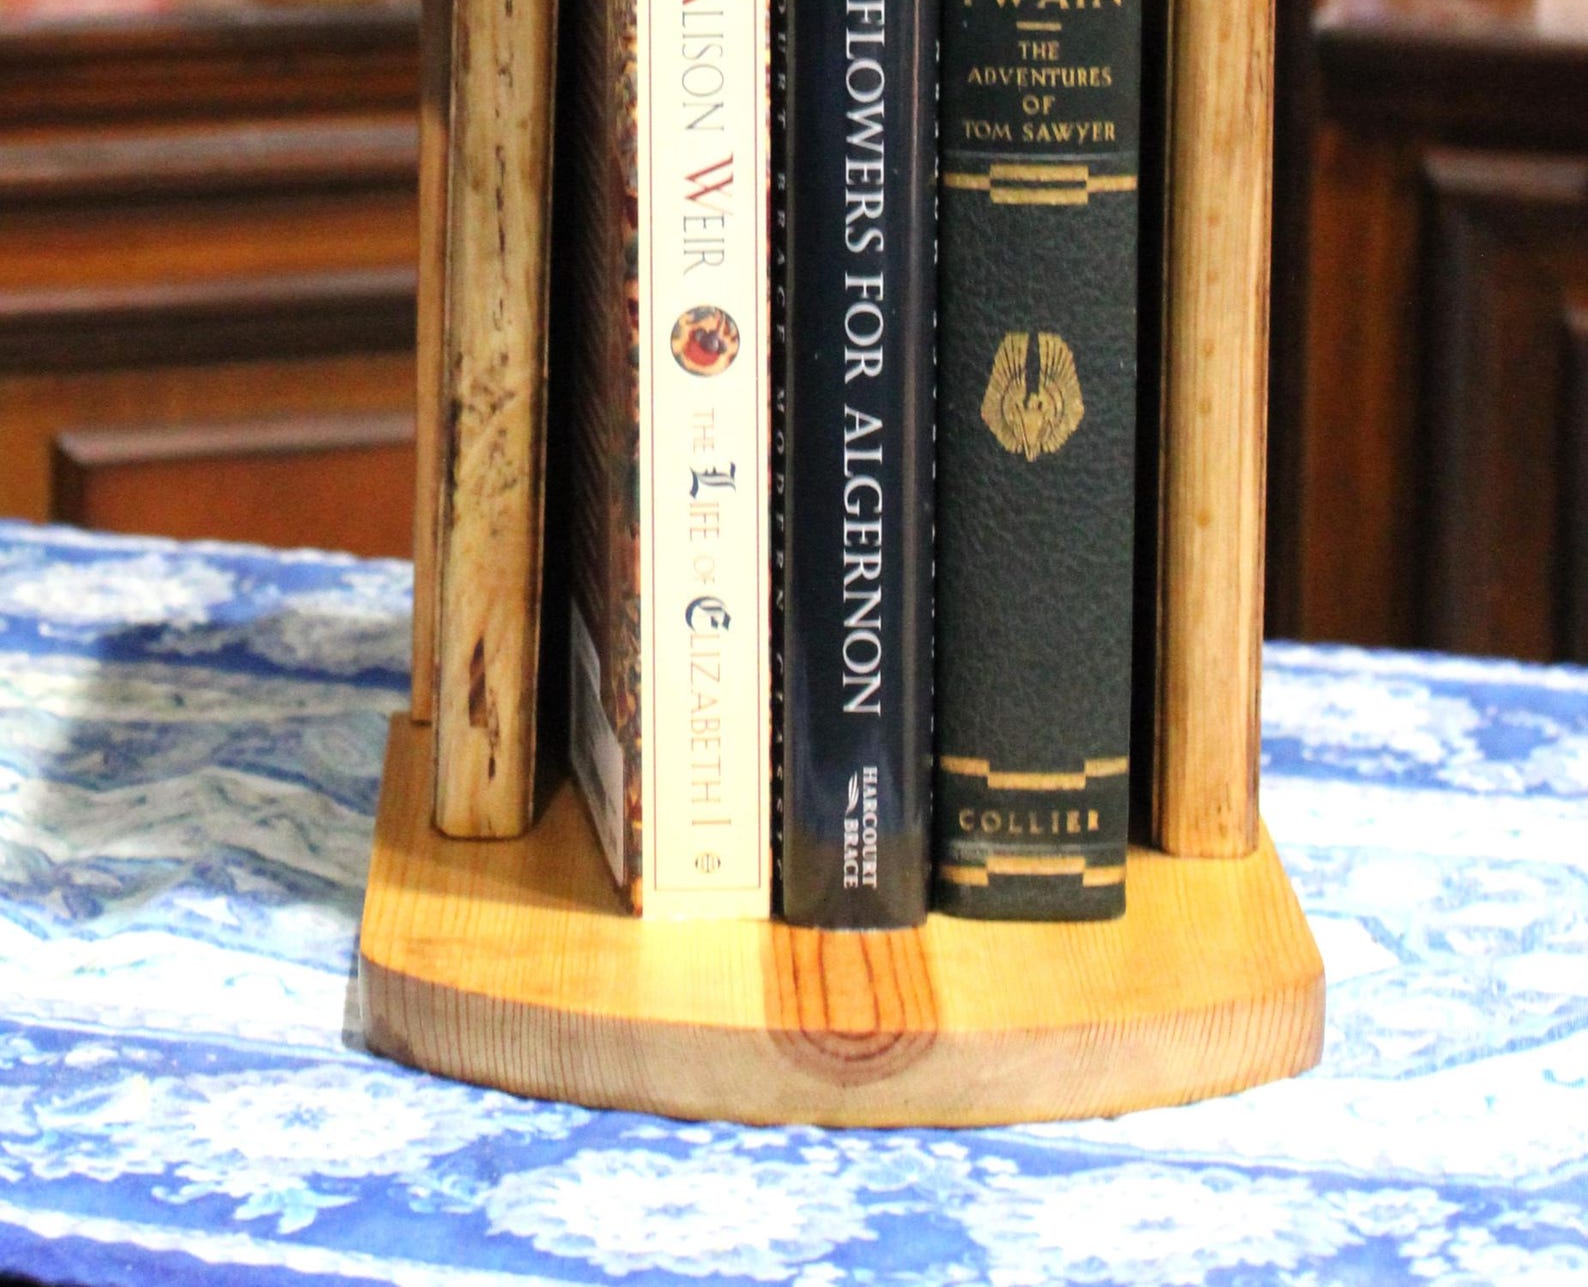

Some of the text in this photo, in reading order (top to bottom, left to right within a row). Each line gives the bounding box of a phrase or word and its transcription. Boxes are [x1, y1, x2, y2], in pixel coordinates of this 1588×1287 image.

[967, 65, 1113, 87] ADVENTURES
[1017, 39, 1060, 61] THE
[961, 119, 1117, 145] TOM SAWYER
[1021, 94, 1055, 115] OF
[683, 151, 734, 275] WEIR
[844, 271, 885, 384] FOR
[842, 404, 884, 717] ALGERNON
[684, 407, 737, 827] THE LIFE OF ELIZABETH I
[843, 818, 860, 889] BRACE
[862, 766, 878, 890] HARCOURT
[958, 809, 1100, 834] COLLIER
